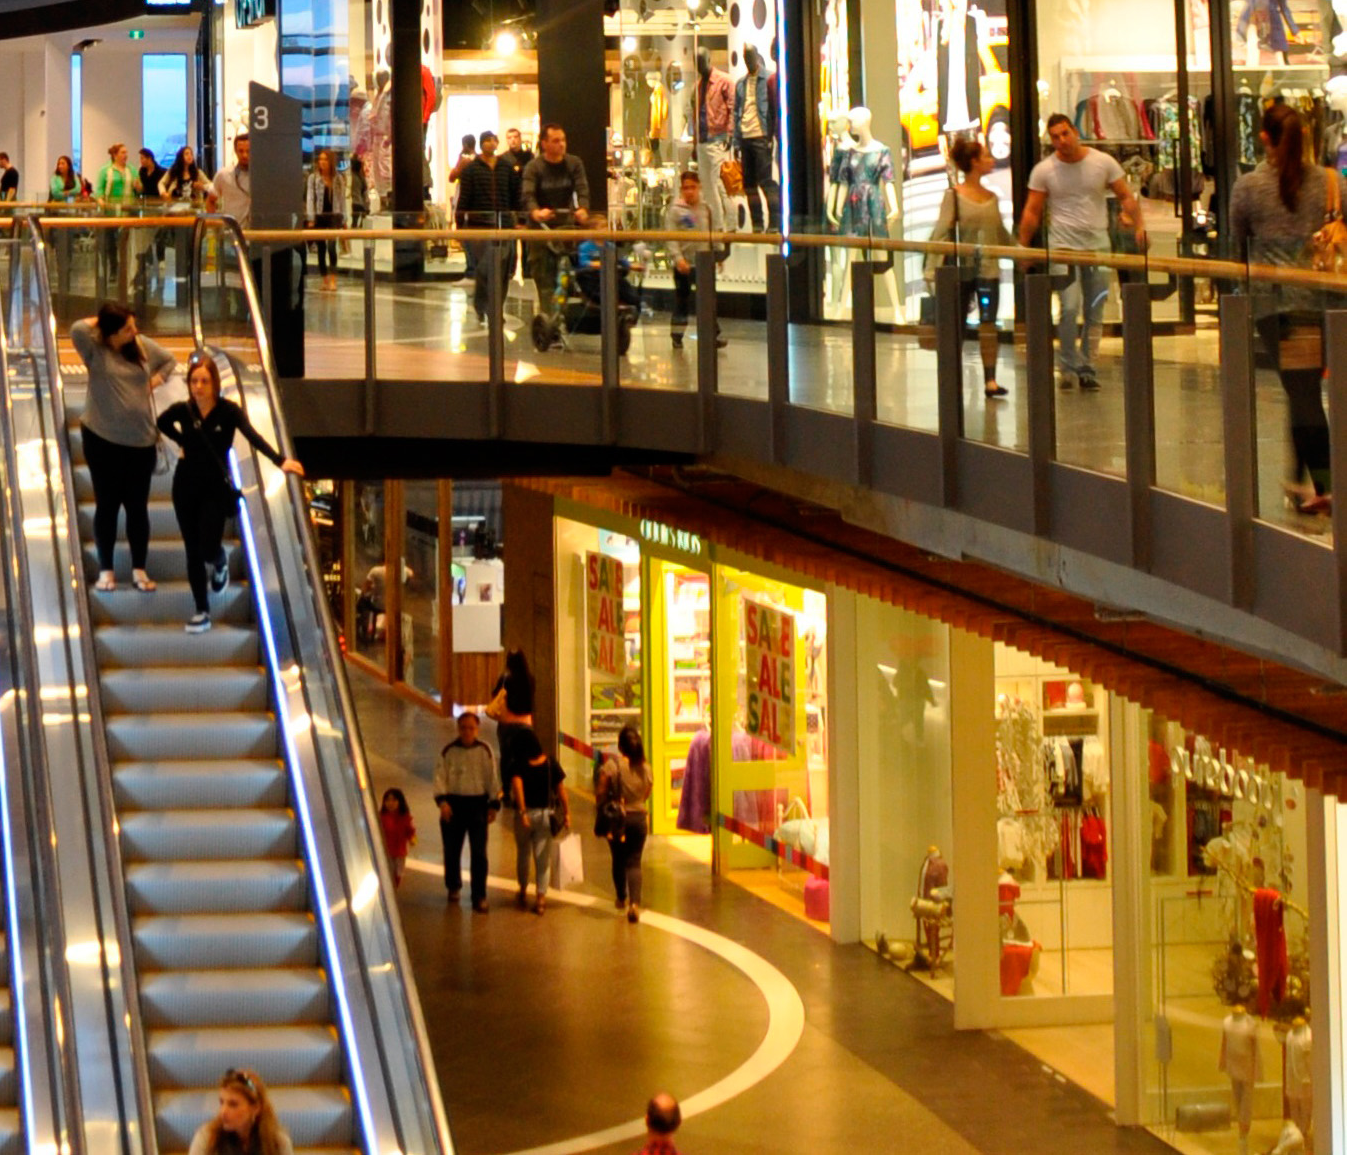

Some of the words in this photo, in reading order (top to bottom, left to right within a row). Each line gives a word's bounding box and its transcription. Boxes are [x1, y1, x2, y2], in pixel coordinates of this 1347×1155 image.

[254, 105, 269, 130] 3
[588, 593, 624, 636] ALE
[747, 649, 791, 703] ALE
[747, 693, 791, 749] SAL
